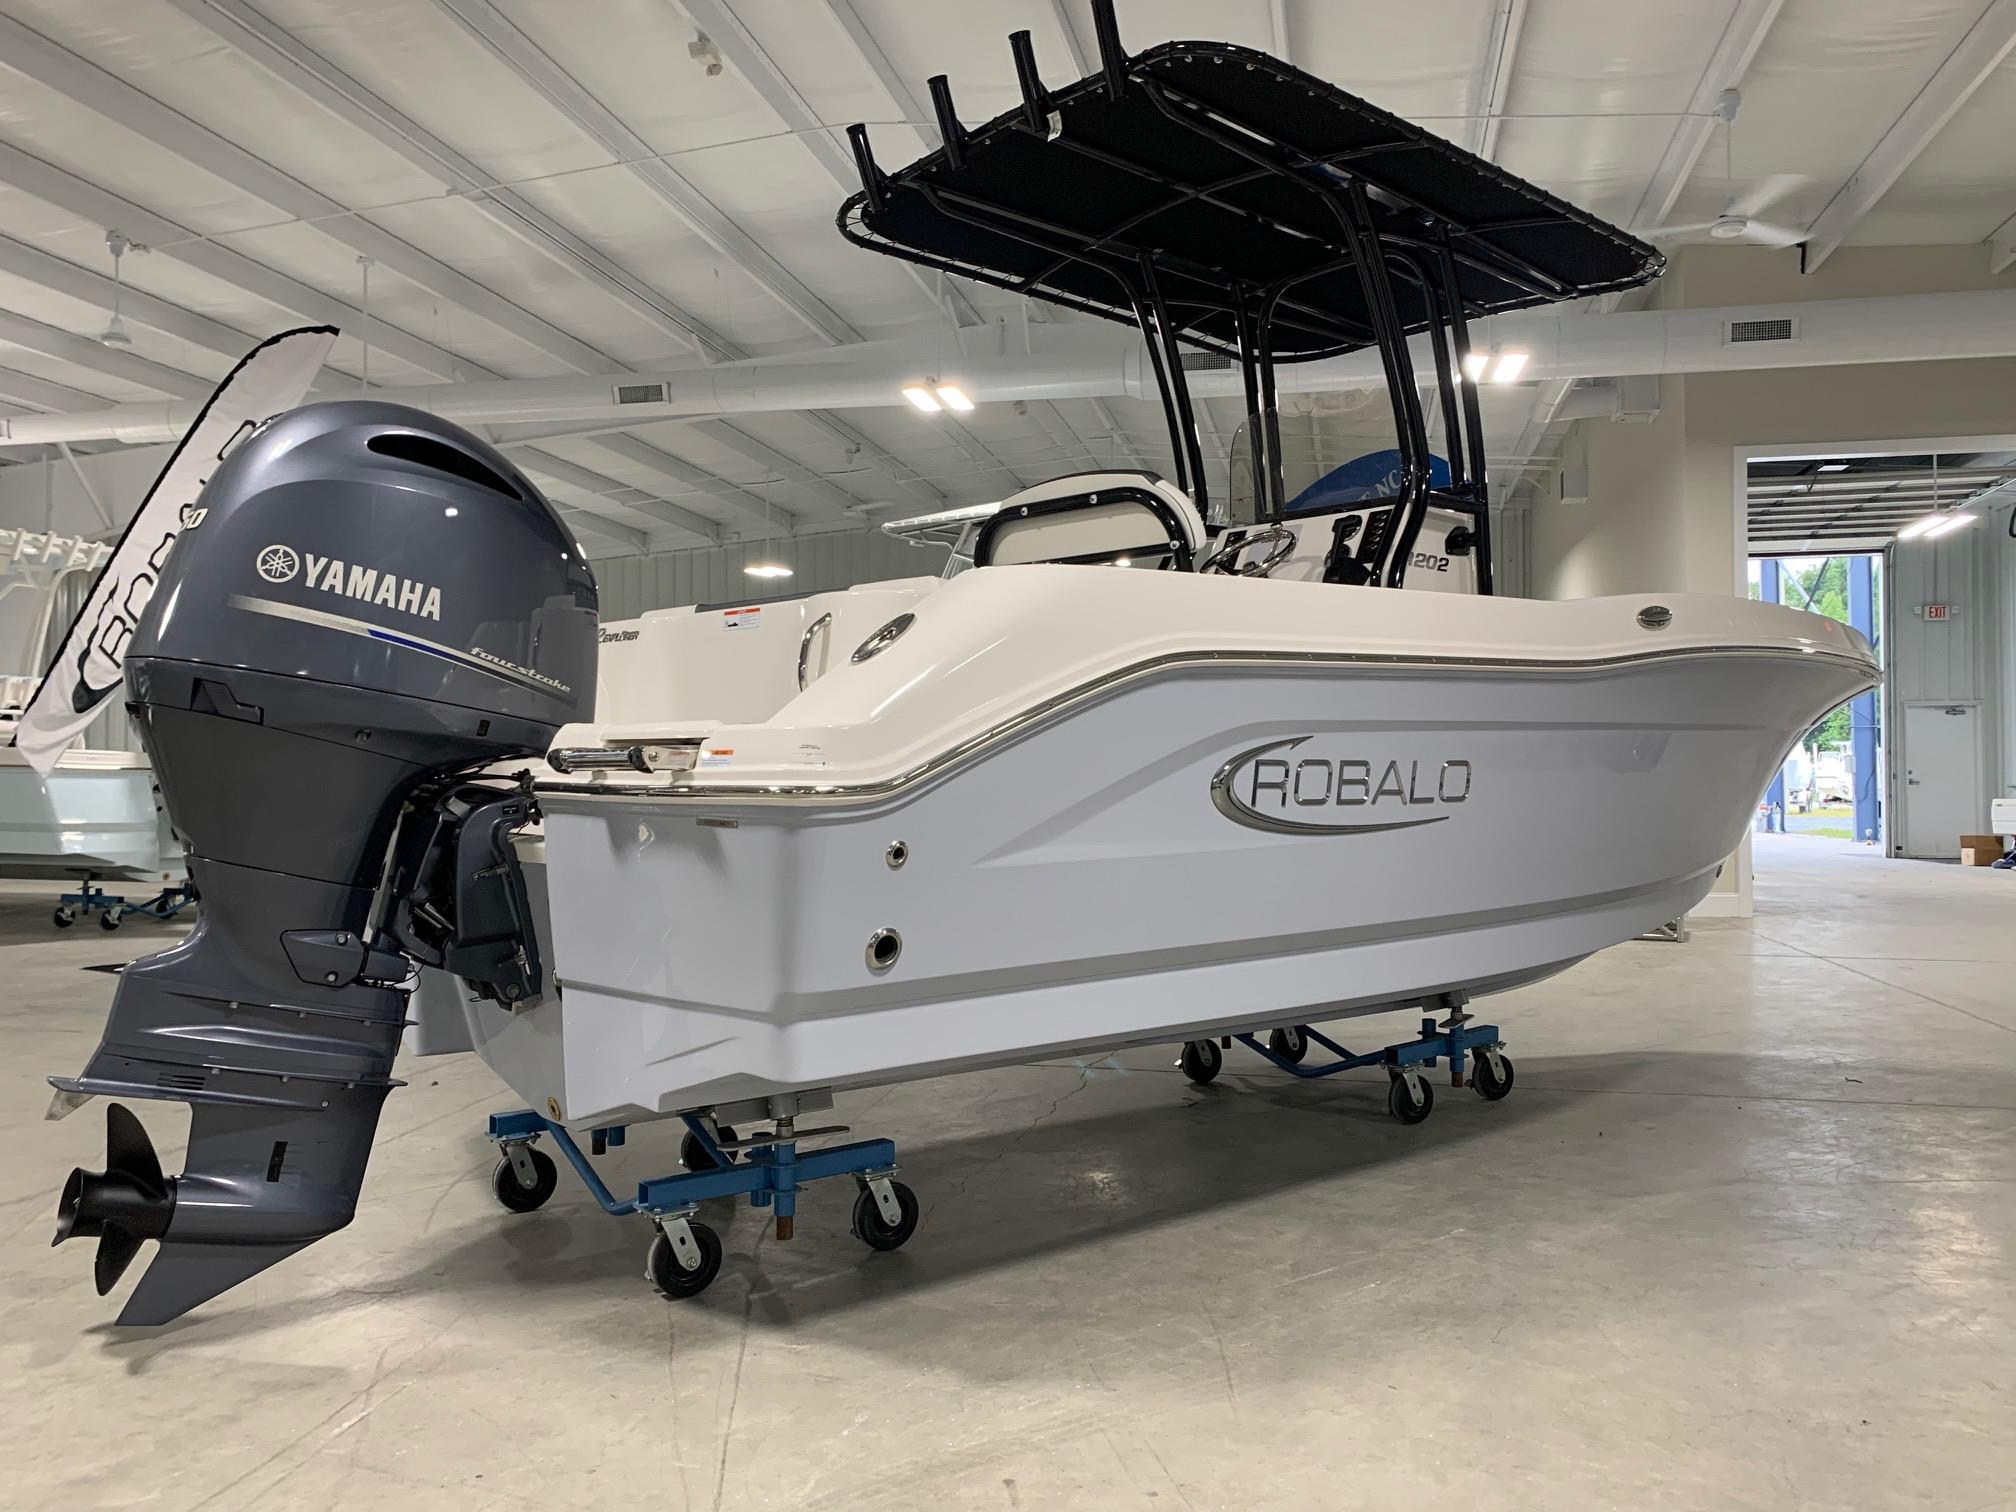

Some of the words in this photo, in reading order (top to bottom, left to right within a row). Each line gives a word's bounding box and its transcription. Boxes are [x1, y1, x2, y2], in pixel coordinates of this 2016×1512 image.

[305, 553, 441, 621] YAMAHA
[1929, 606, 1946, 619] EXIT
[1251, 759, 1472, 808] ROBALO
